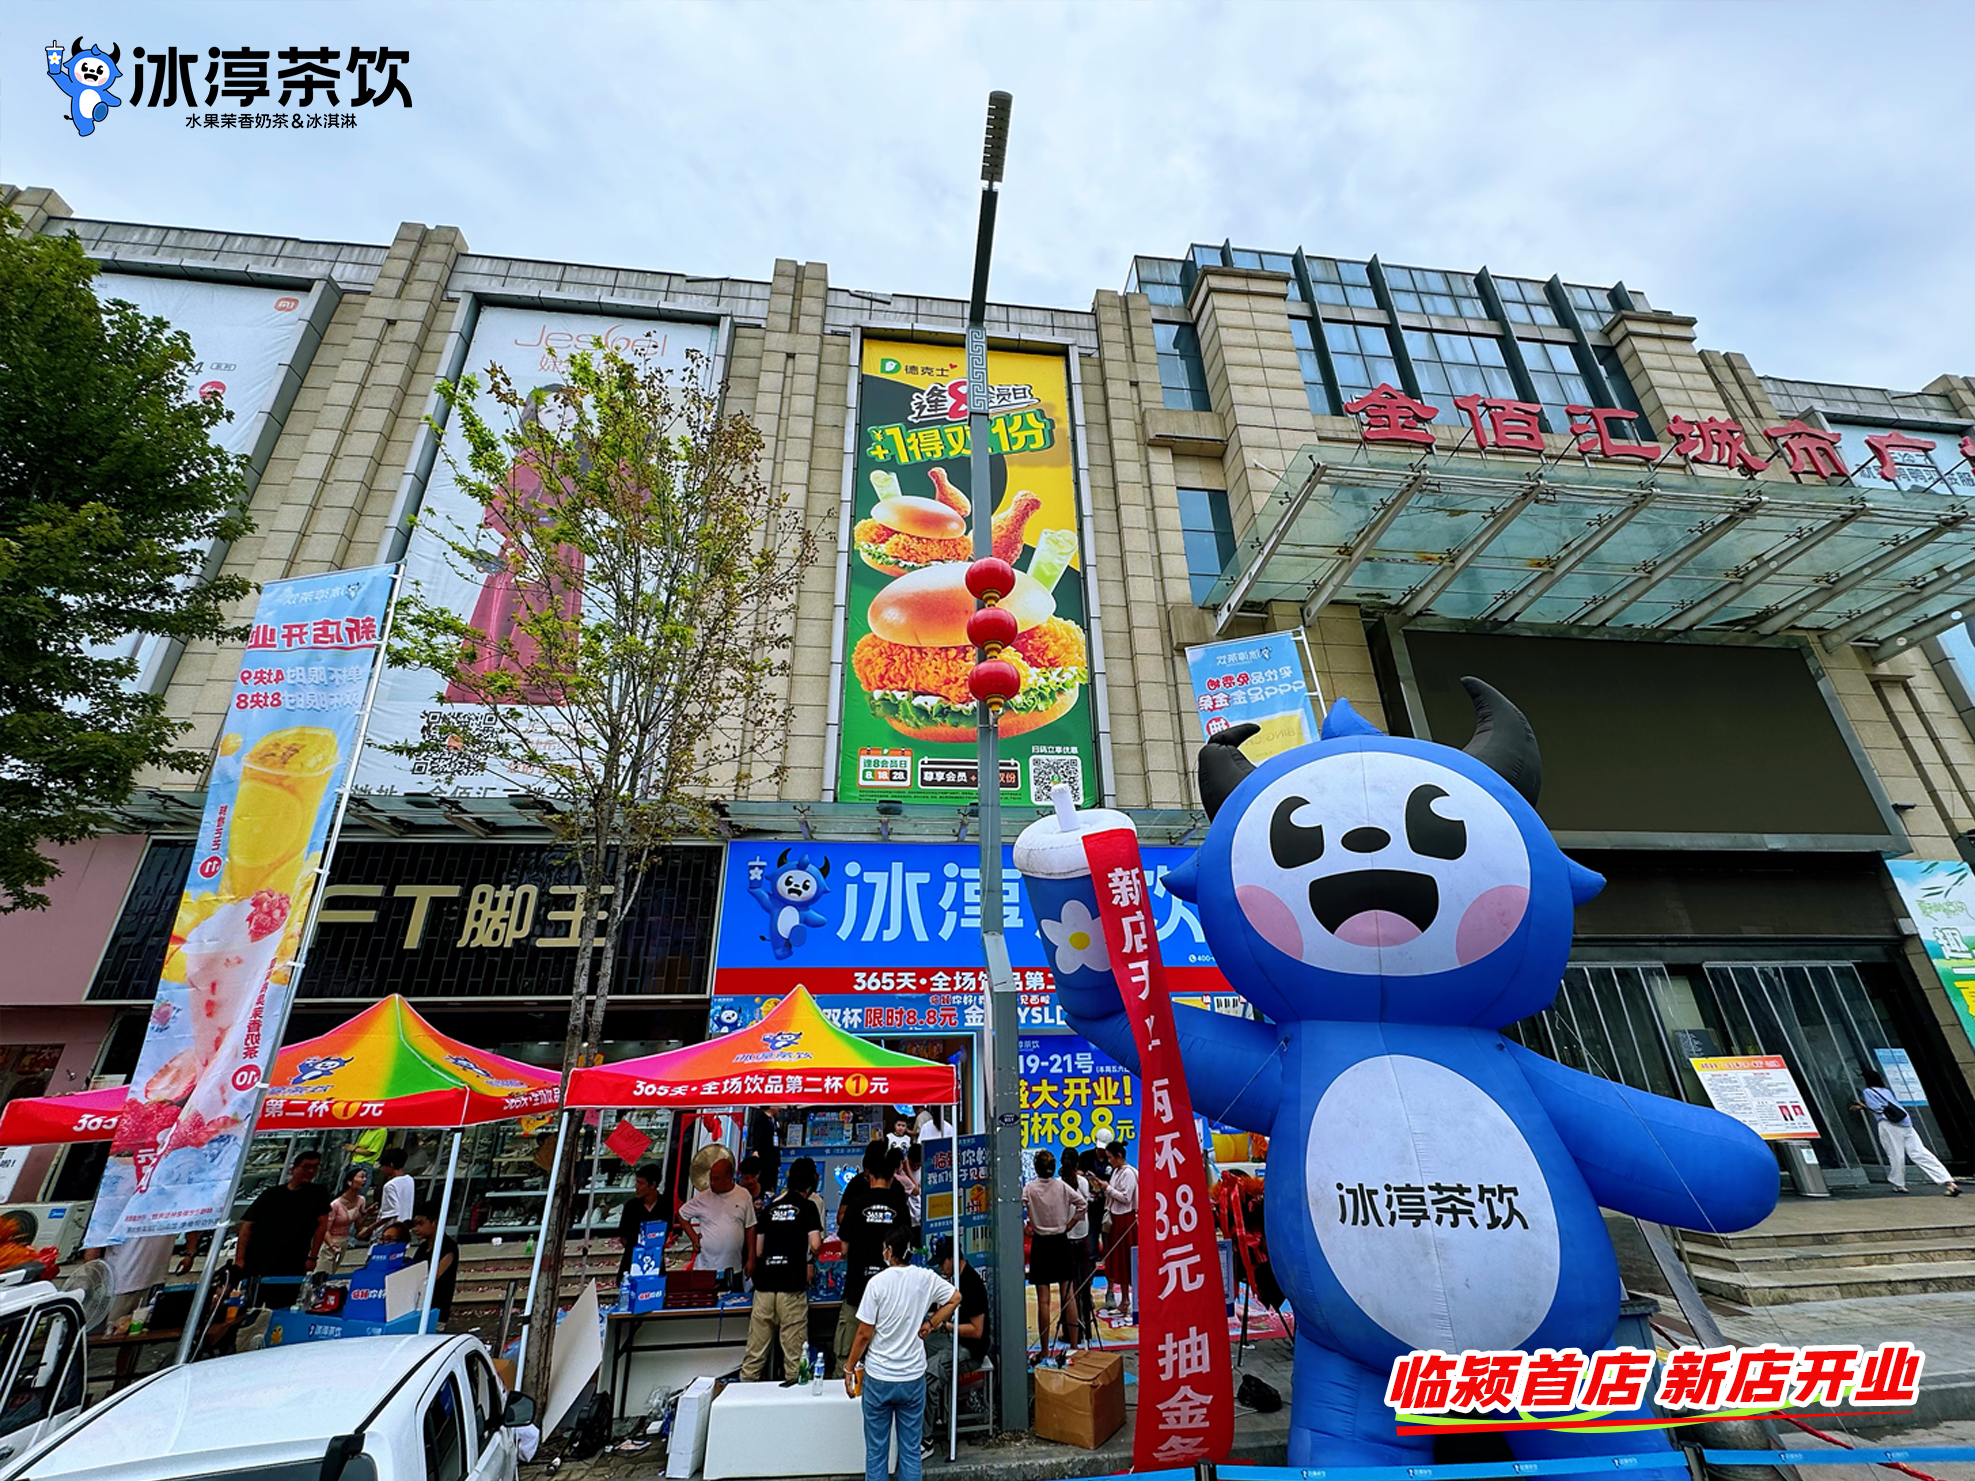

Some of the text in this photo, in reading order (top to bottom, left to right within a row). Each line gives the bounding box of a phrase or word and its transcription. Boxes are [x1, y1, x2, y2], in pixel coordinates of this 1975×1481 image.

[904, 364, 950, 377] 德克士
[1336, 1182, 1529, 1230] 冰淳茶饮
